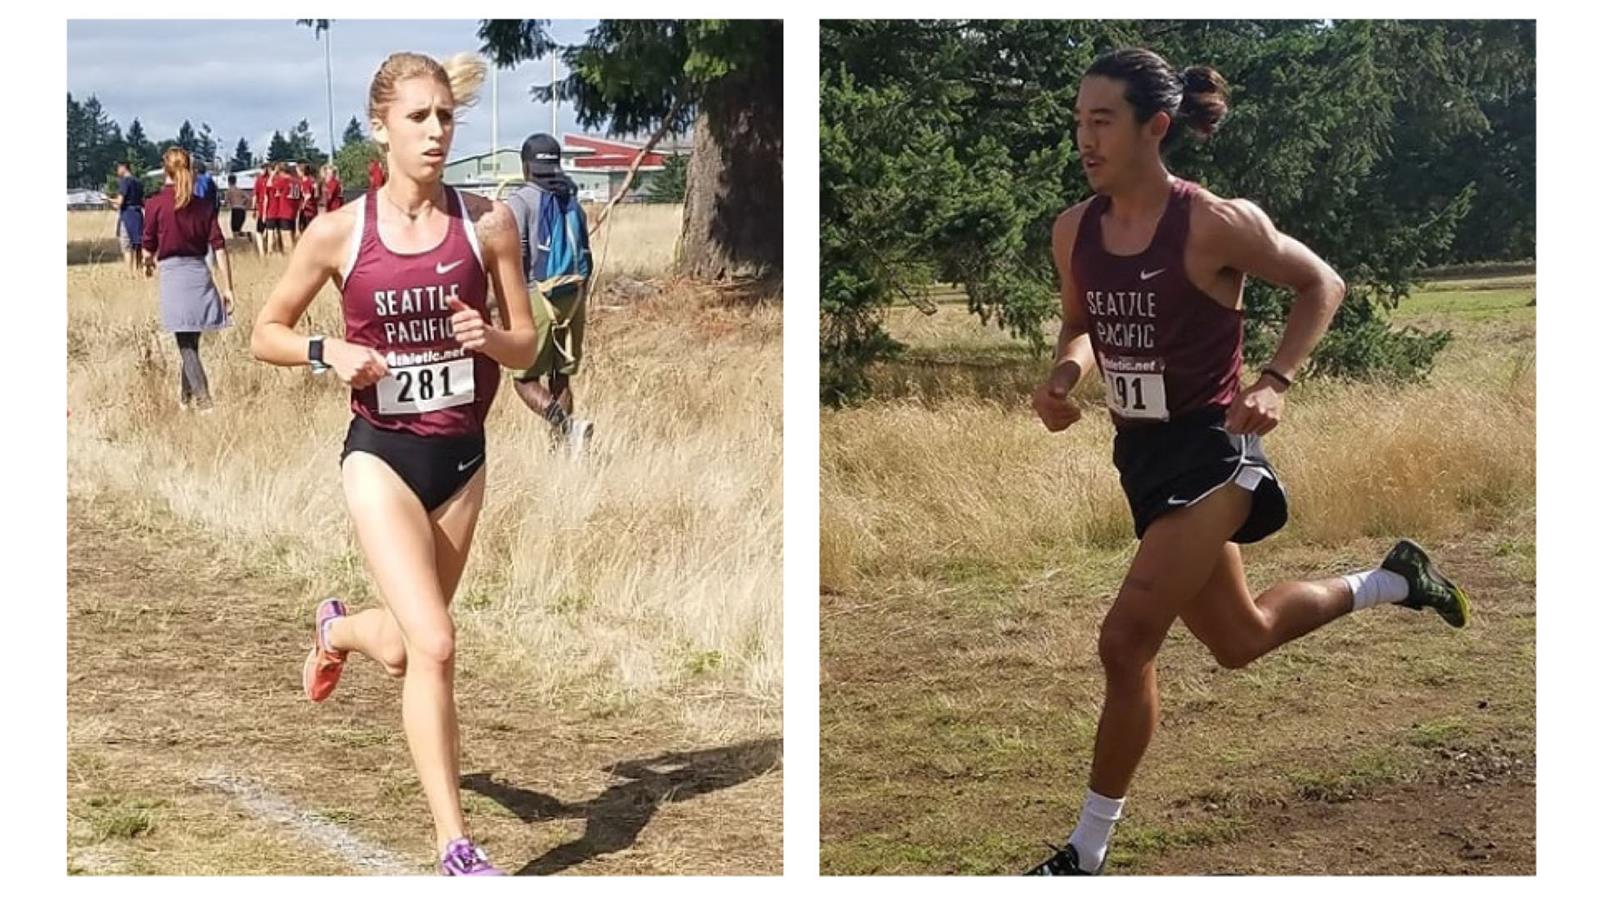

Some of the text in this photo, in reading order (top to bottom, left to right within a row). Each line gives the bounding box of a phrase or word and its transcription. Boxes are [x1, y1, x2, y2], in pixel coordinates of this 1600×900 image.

[1087, 291, 1157, 317] SEATTLE
[1097, 321, 1155, 349] PACIFIC
[396, 366, 454, 403] 281
